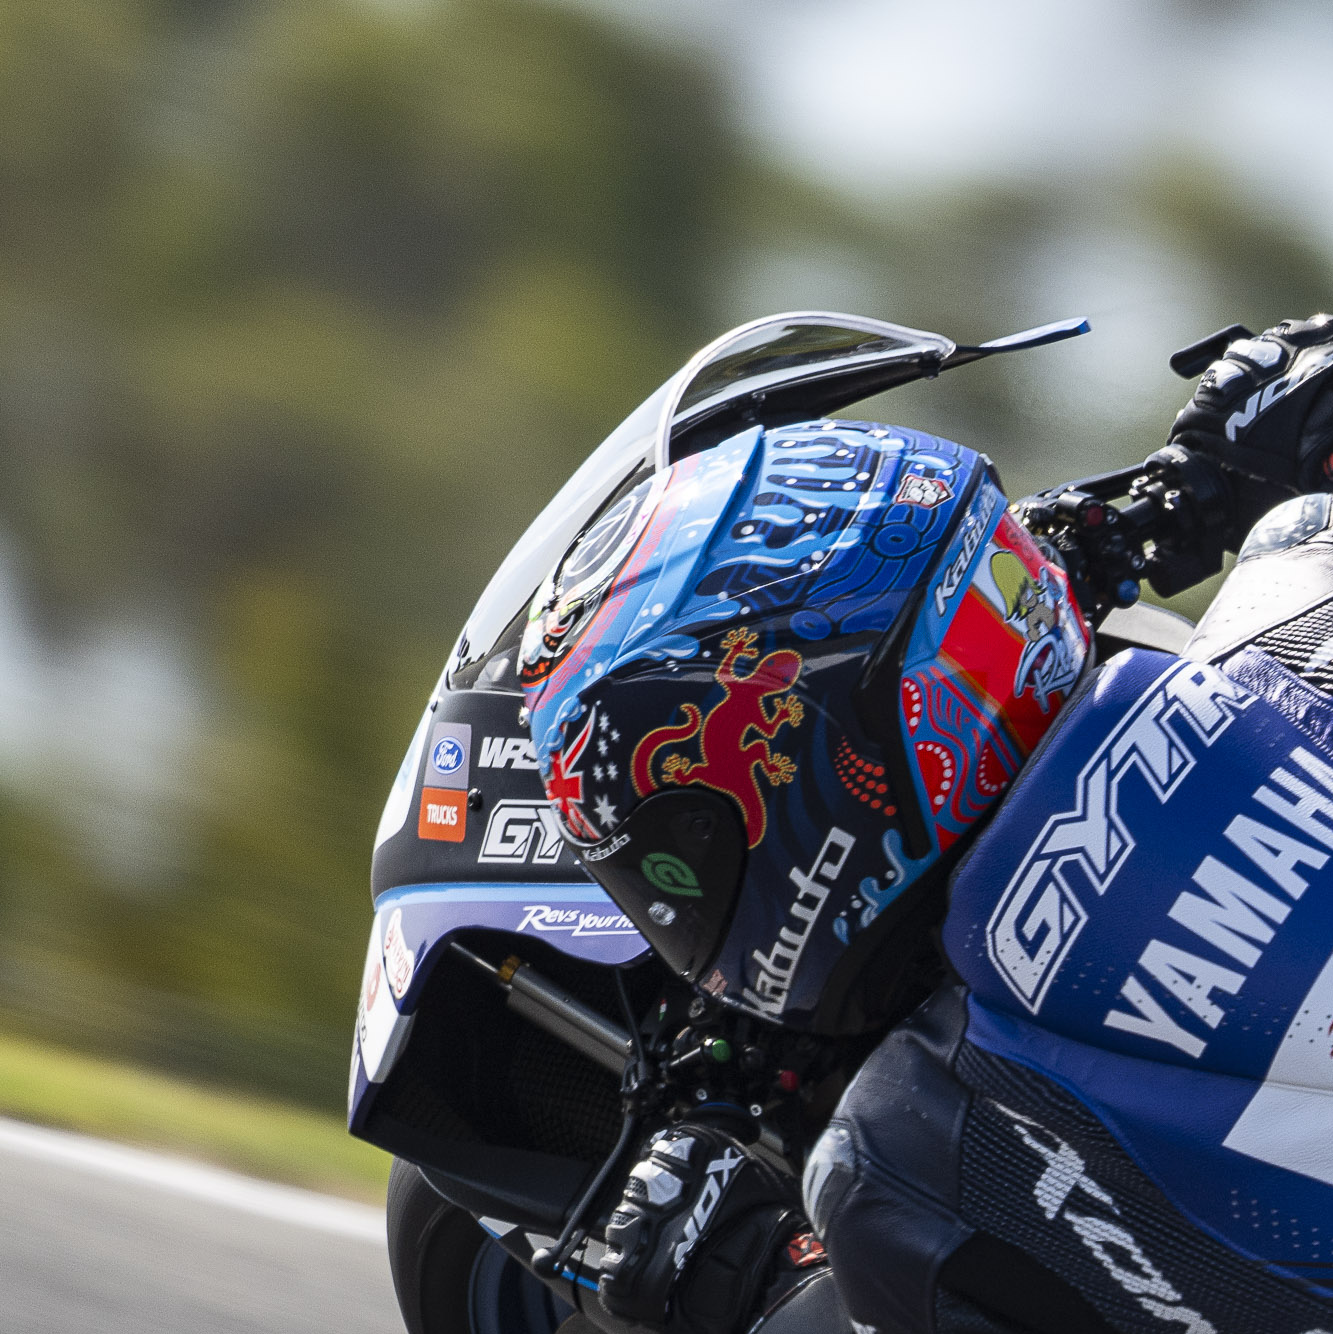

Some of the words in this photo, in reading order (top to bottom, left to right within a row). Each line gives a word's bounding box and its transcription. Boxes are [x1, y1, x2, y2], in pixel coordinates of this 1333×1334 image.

[427, 804, 458, 825] TRUCKS
[986, 661, 1259, 1014] GYTR
[742, 827, 857, 1021] Kabuto
[675, 1147, 742, 1270] XON
